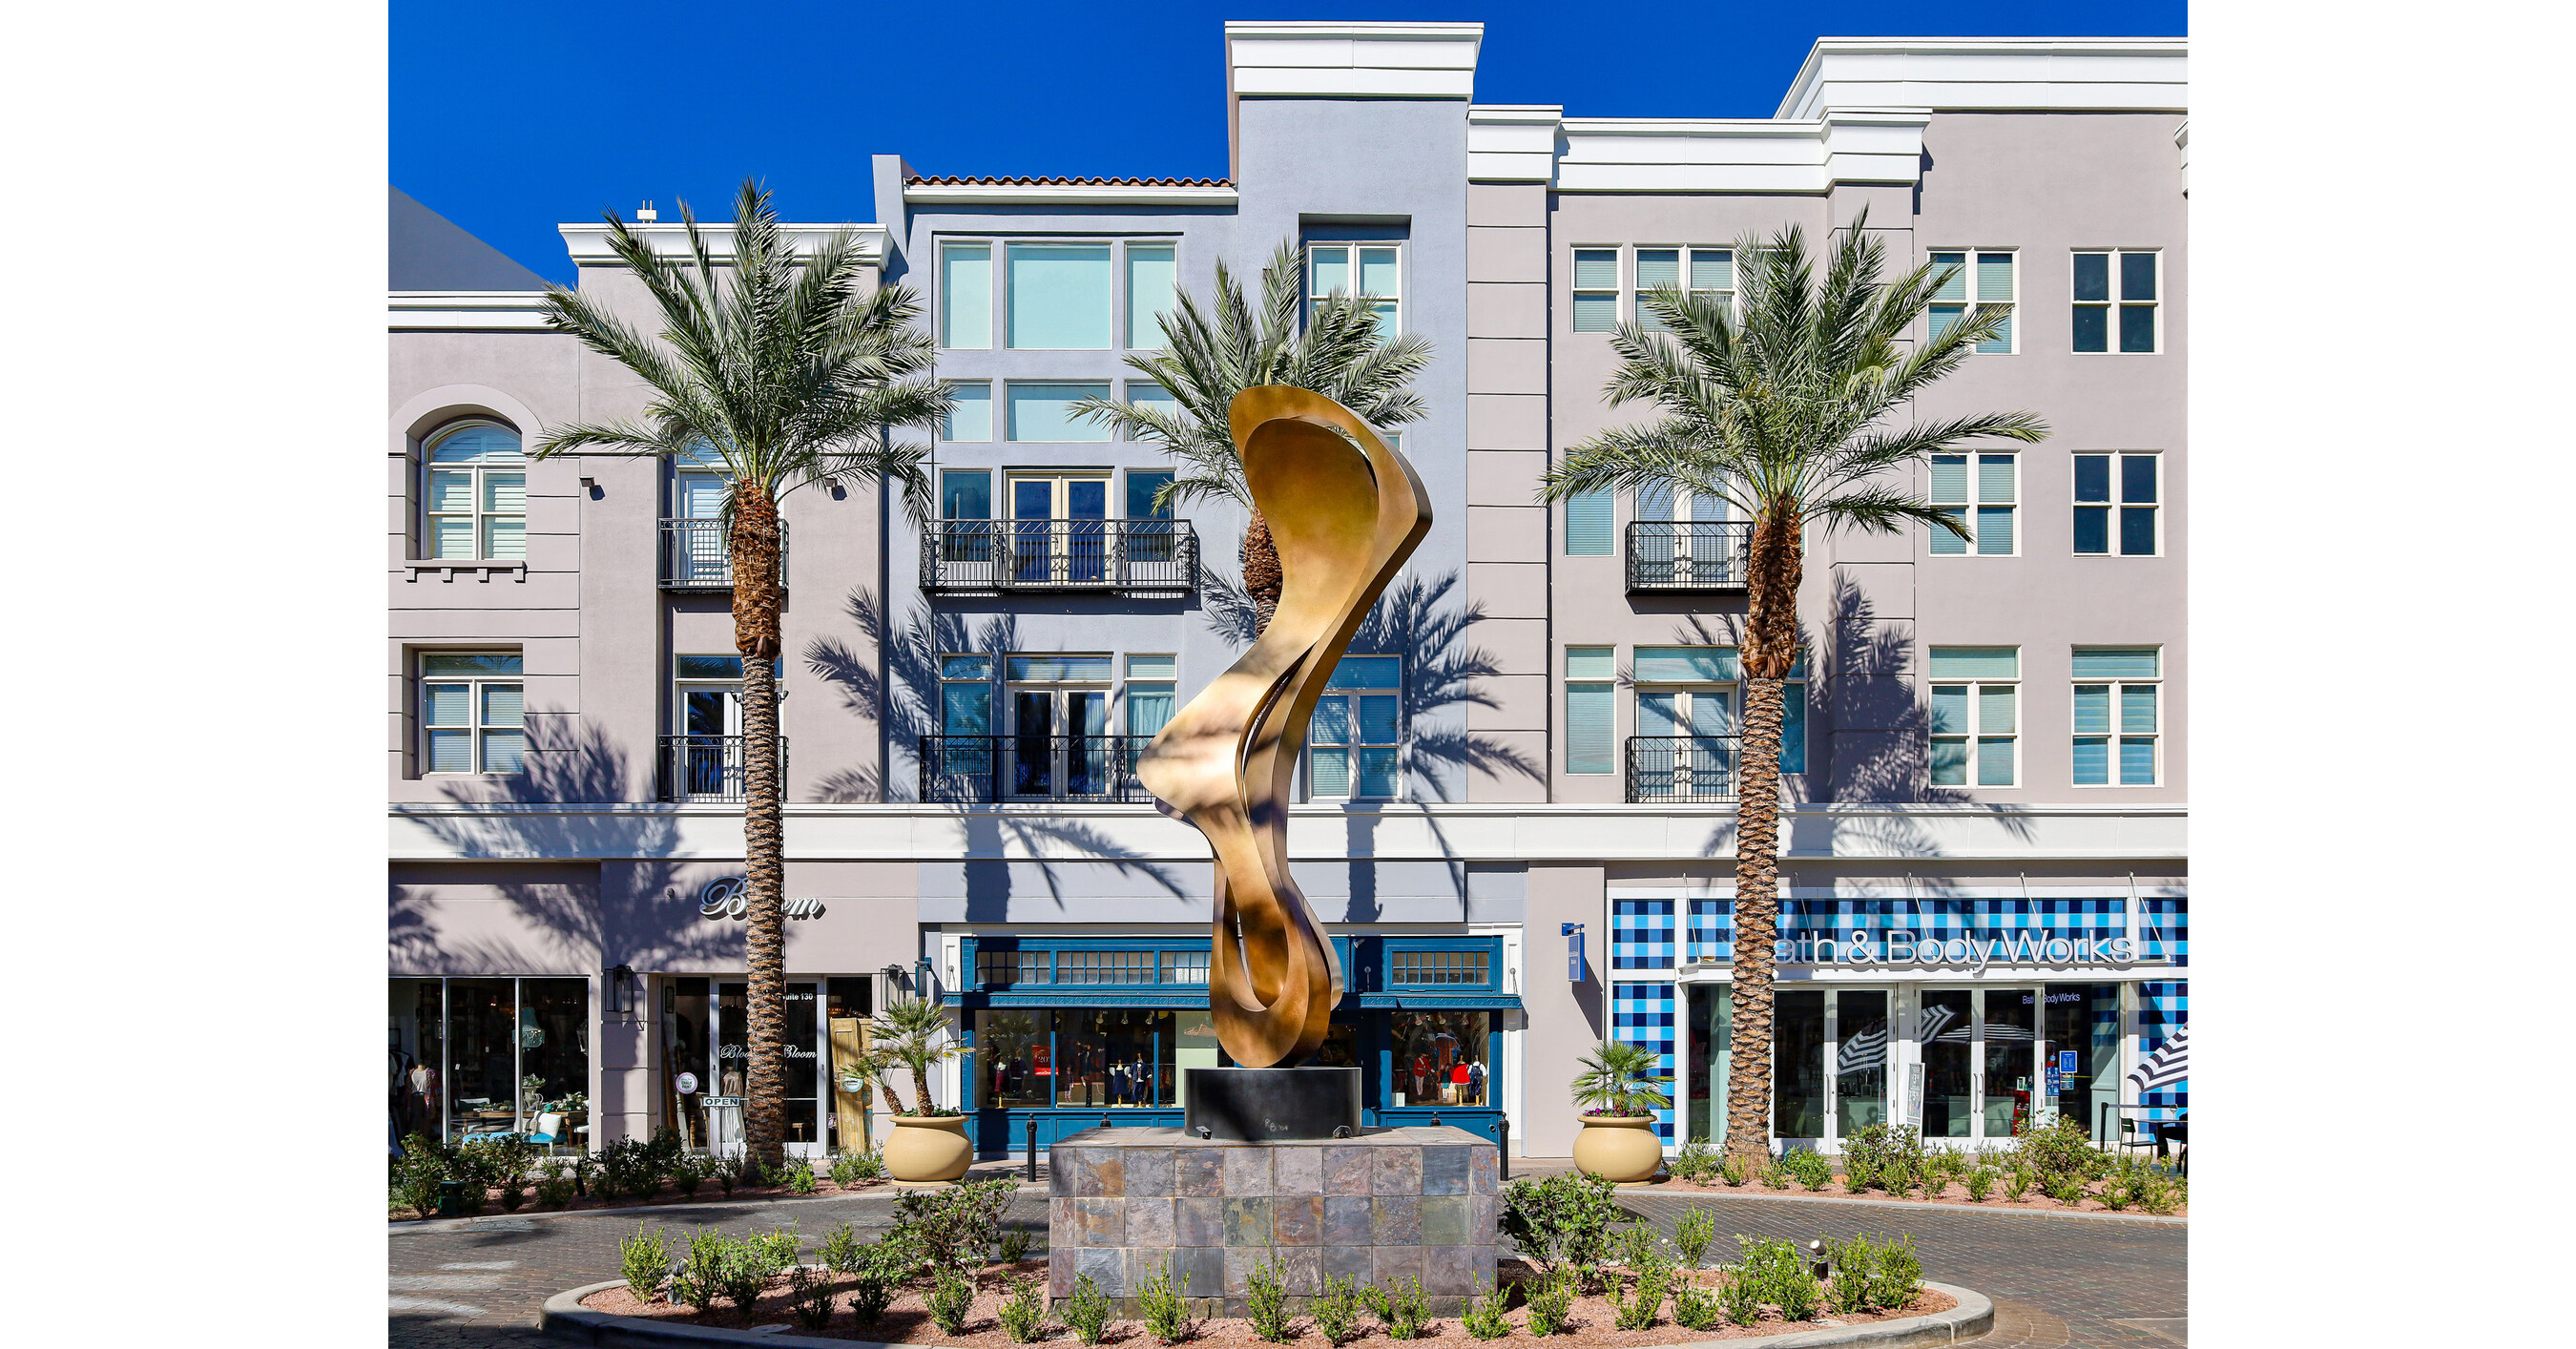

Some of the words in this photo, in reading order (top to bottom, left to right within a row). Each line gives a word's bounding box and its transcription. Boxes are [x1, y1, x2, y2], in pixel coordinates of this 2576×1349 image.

[1774, 930, 1839, 965] ath
[1846, 930, 1880, 965] &
[1887, 930, 1997, 974] Body
[2002, 929, 2135, 965] Works
[2059, 992, 2080, 1002] Works
